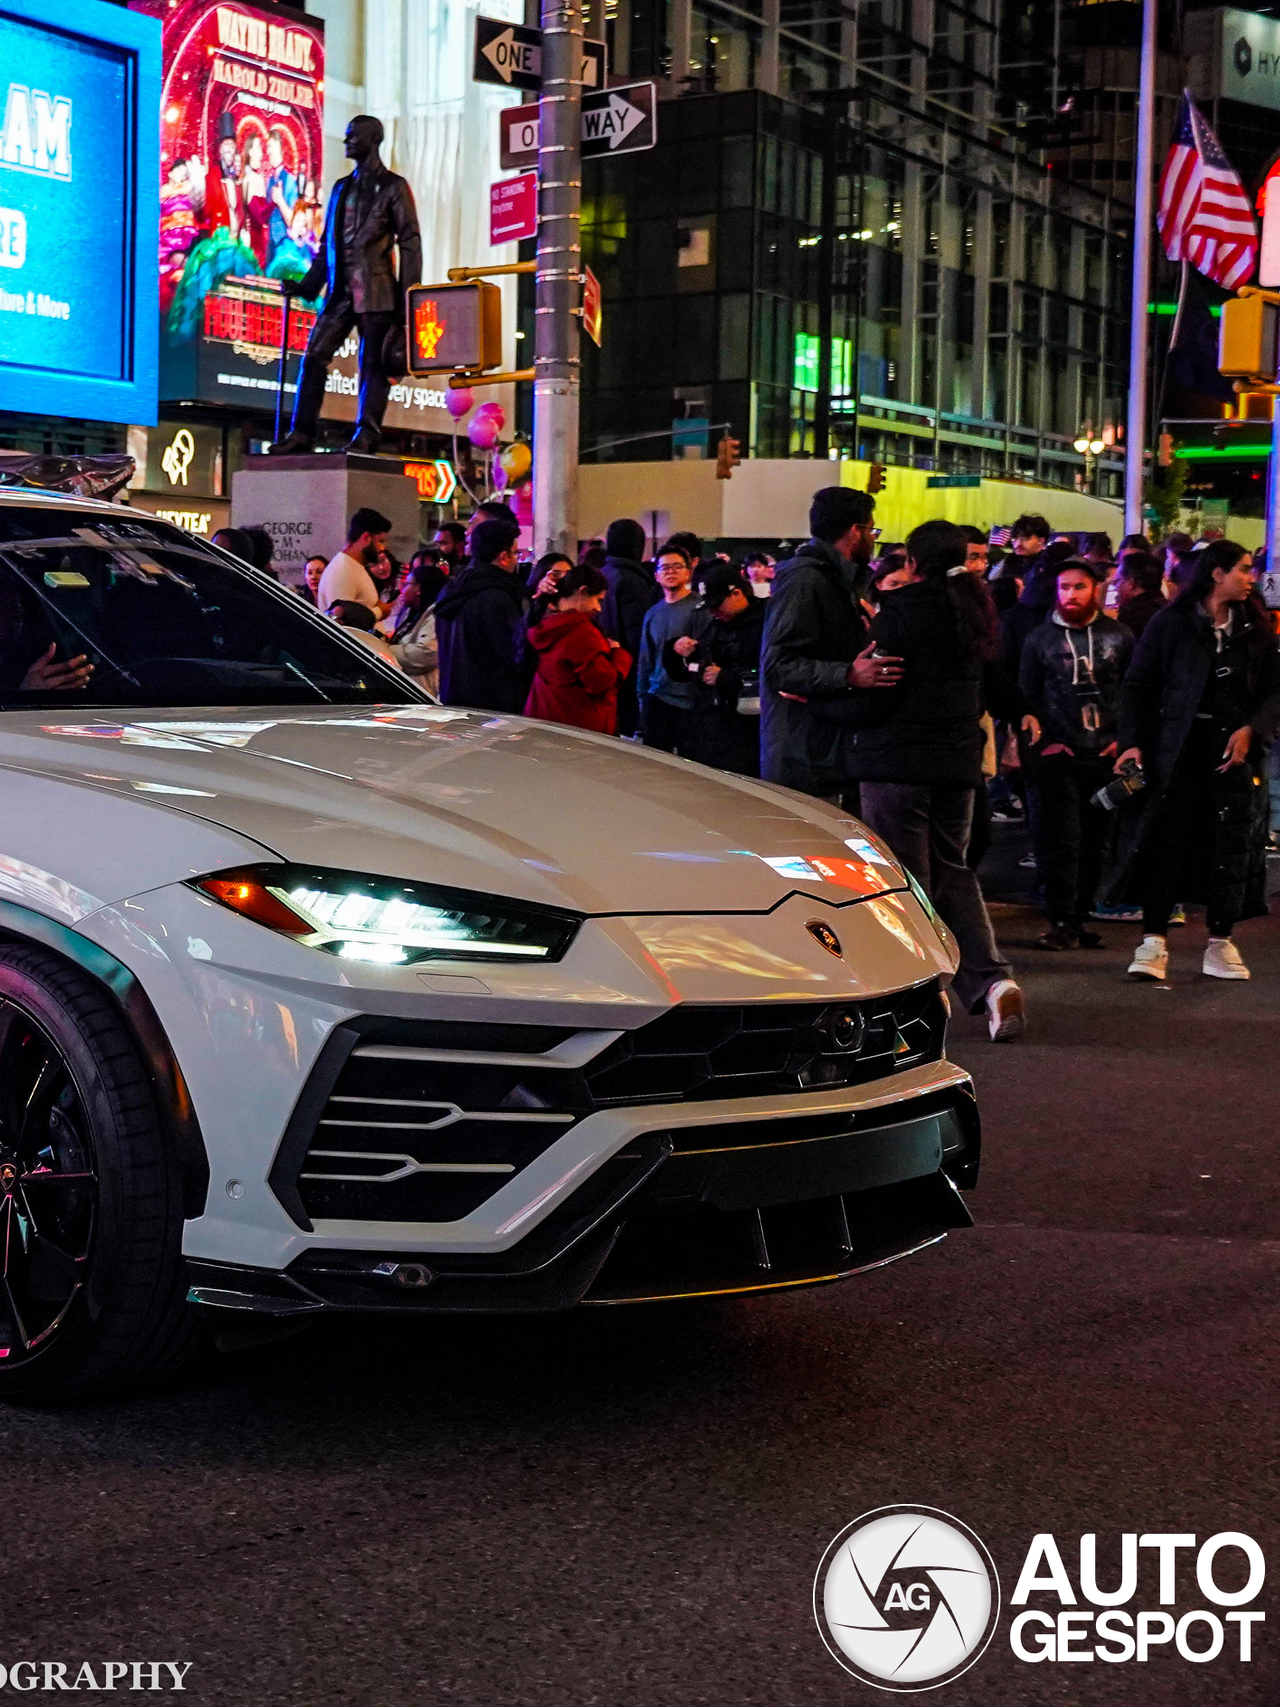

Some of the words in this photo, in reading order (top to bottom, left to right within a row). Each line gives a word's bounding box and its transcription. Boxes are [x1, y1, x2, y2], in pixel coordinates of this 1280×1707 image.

[216, 7, 267, 58] WAYNE
[496, 42, 532, 71] ONE
[213, 58, 268, 94] HAROLD
[268, 76, 314, 109] ZIDLER
[585, 108, 629, 137] WAY
[25, 291, 36, 314] &
[37, 293, 70, 320] More
[263, 522, 312, 535] GEORGE
[273, 550, 308, 561] OHAN
